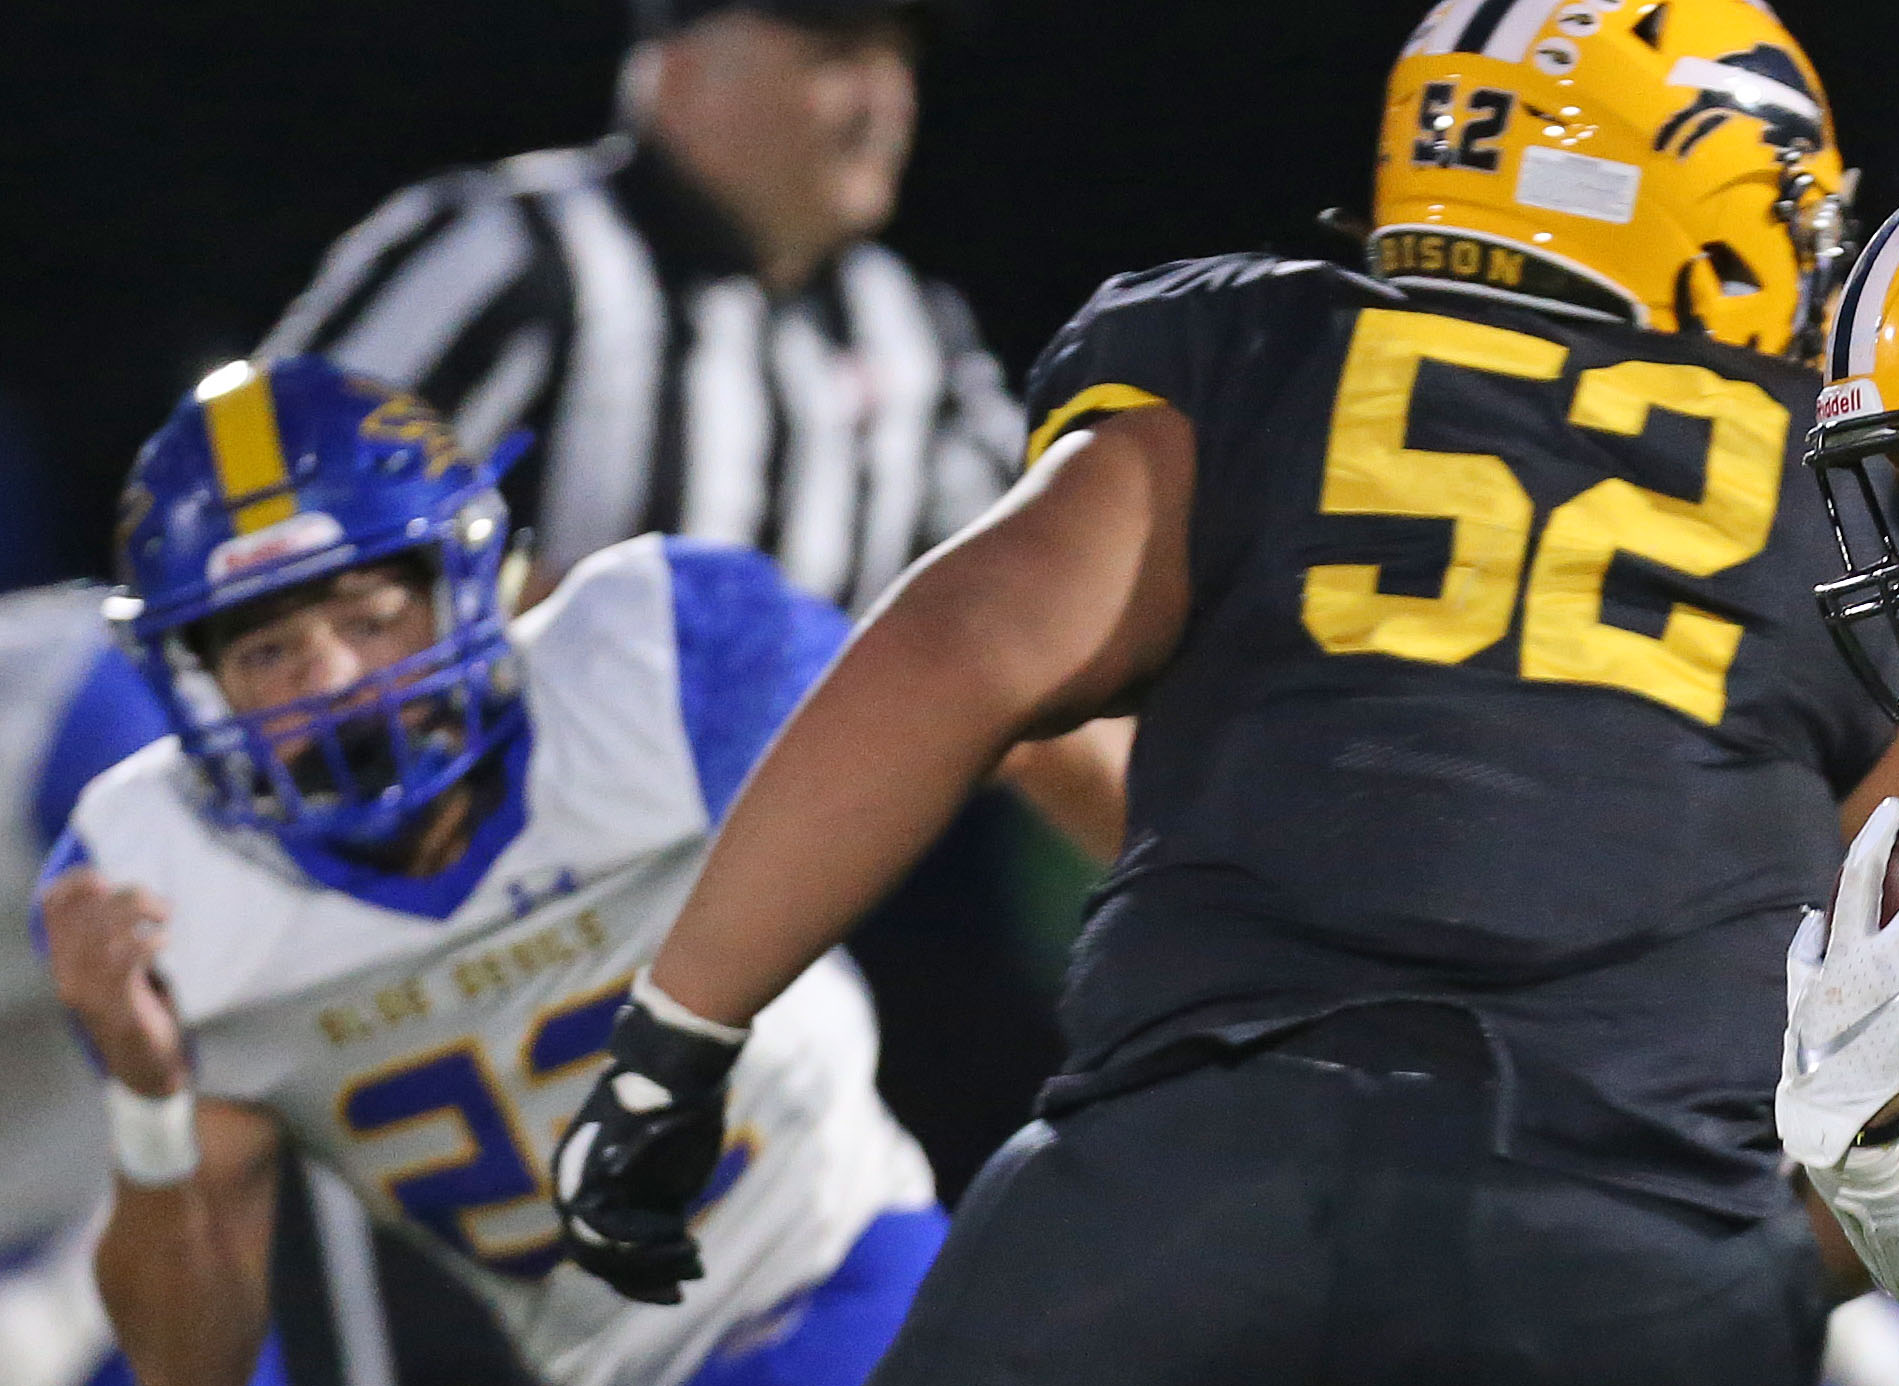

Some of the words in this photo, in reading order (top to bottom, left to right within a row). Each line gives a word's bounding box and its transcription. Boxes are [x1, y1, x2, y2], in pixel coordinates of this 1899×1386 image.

[1412, 82, 1515, 173] 52
[1379, 235, 1525, 287] BISON
[1816, 388, 1861, 418] iddell
[1303, 307, 1790, 725] 52
